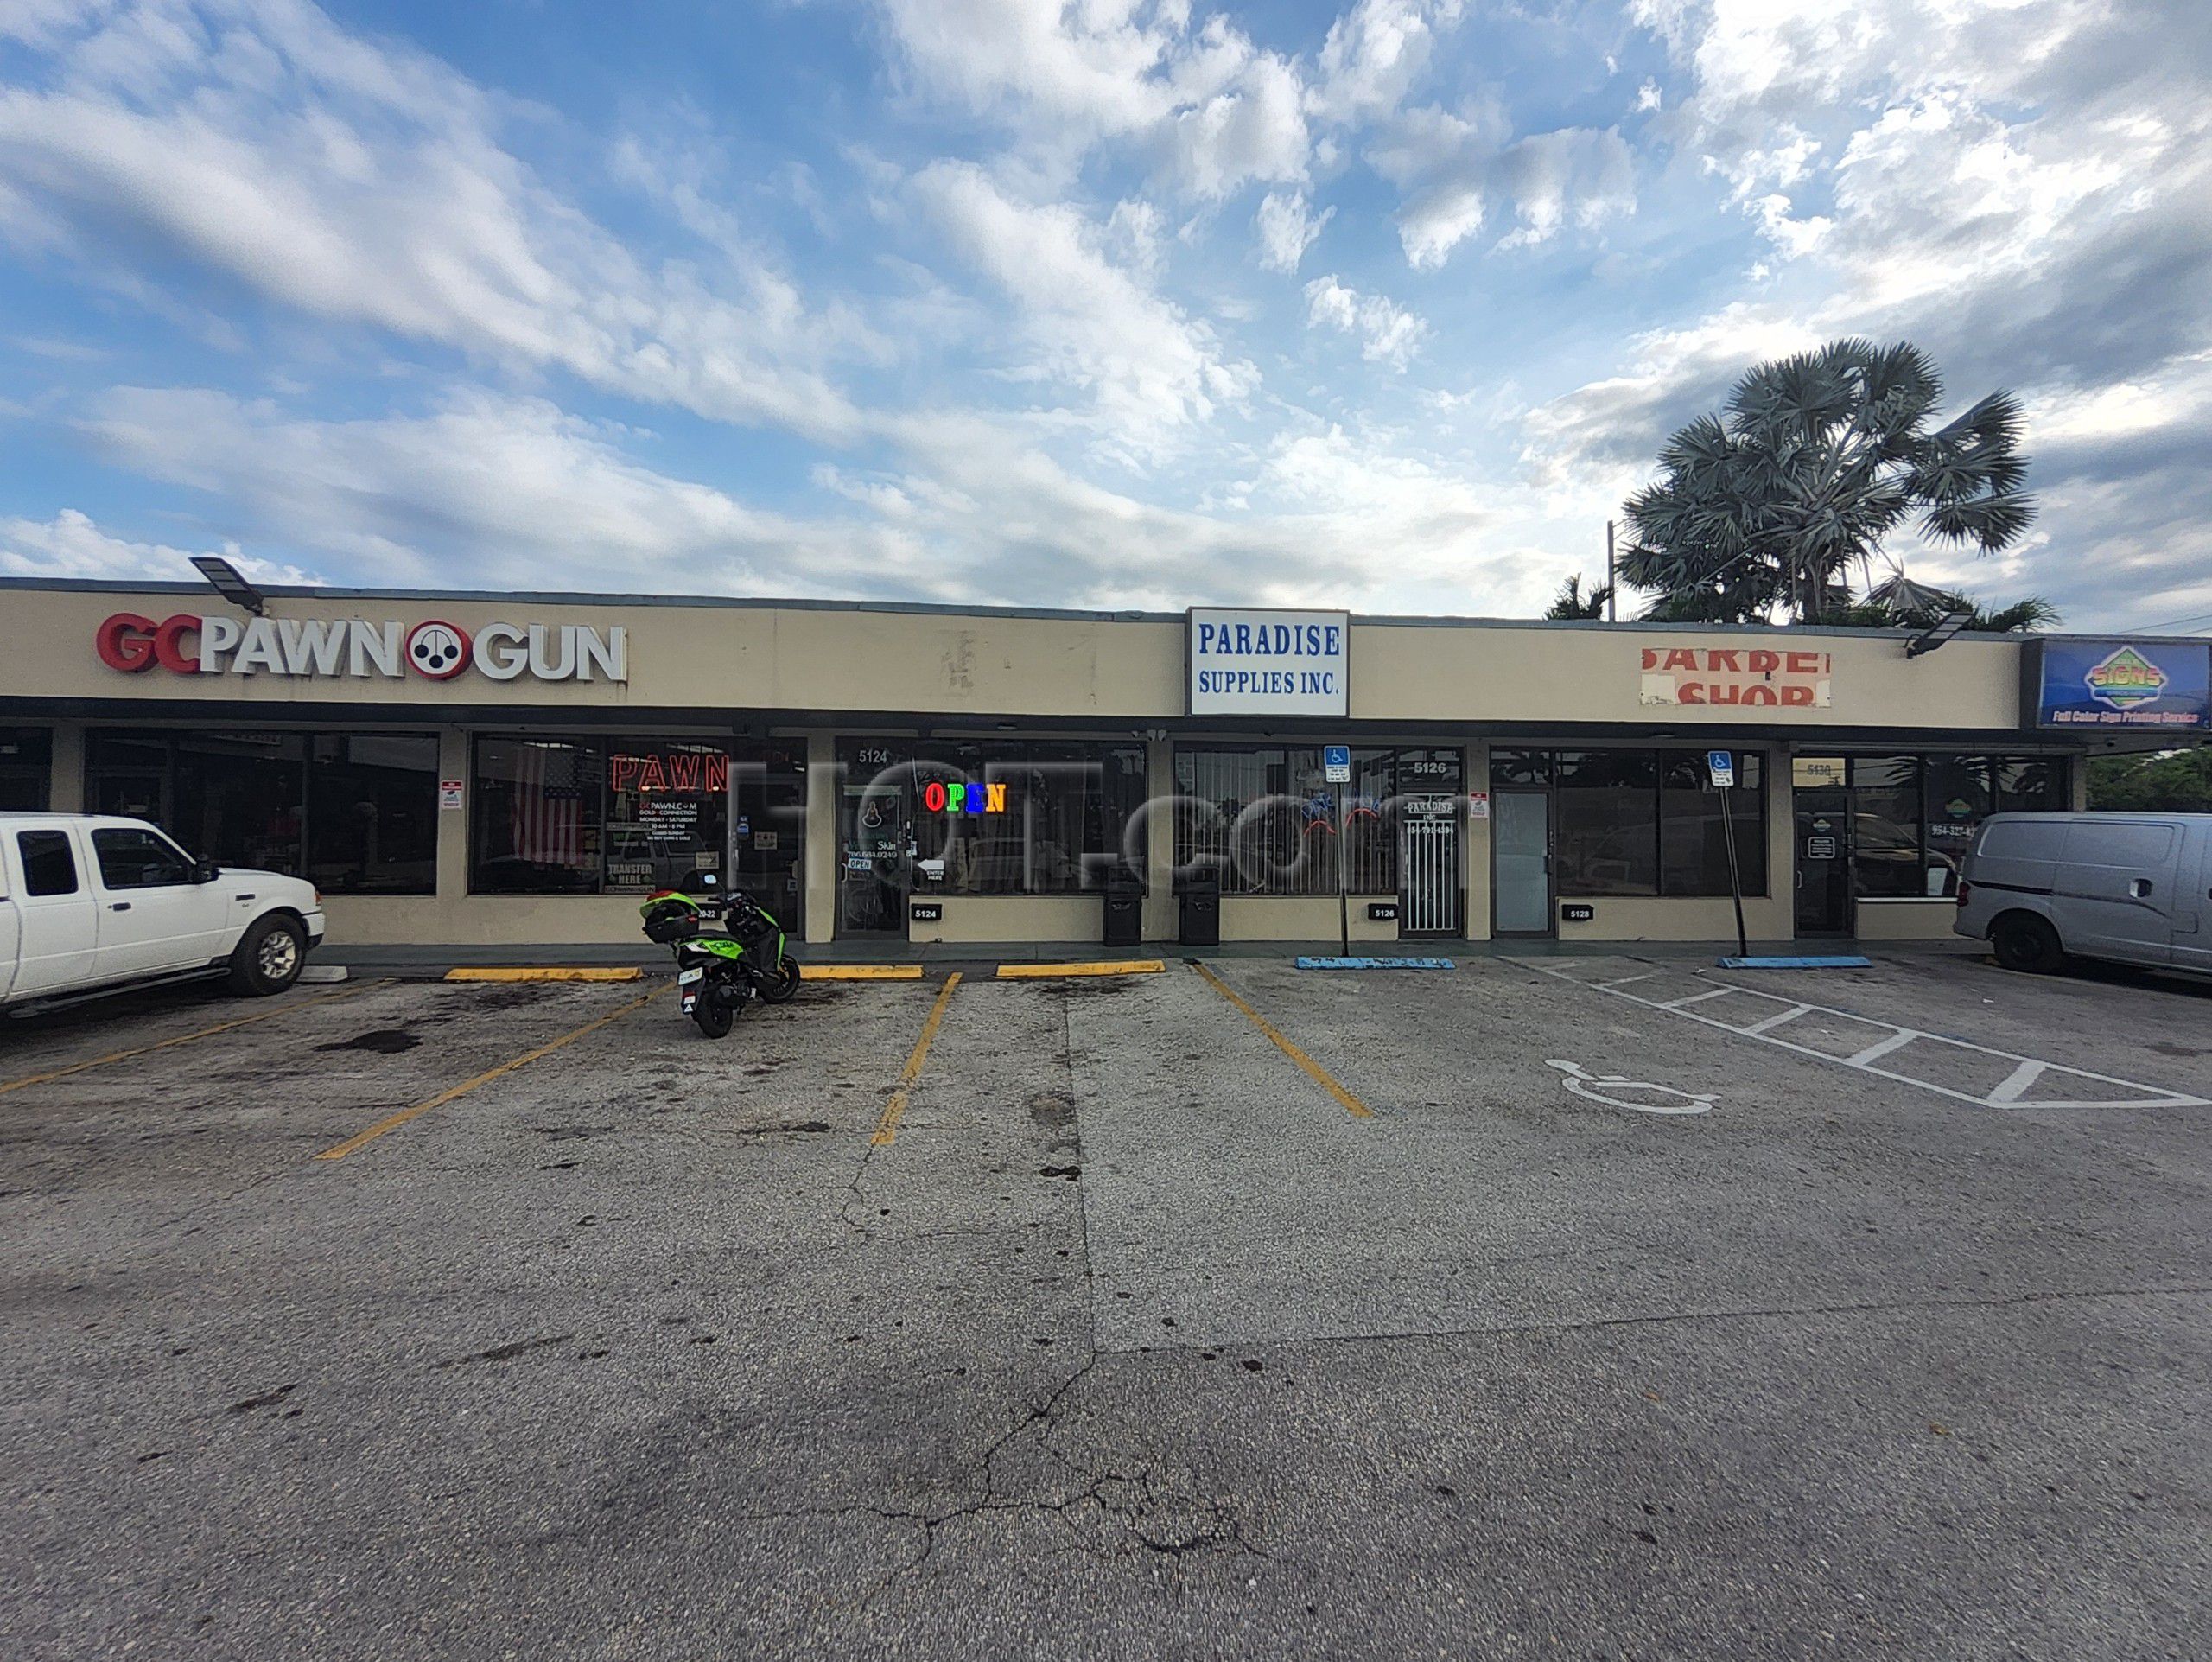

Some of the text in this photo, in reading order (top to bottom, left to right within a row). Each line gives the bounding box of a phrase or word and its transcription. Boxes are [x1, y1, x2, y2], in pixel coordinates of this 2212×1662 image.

[1198, 623, 1339, 656] PARADISE
[472, 621, 627, 681] GUN
[1642, 649, 1830, 673] ARBE
[2092, 665, 2160, 686] SIGNS
[1199, 671, 1339, 694] SUPPLIES INC.
[2053, 711, 2199, 724] Full Color Sign Printing Service
[859, 750, 887, 763] 5124
[612, 754, 730, 793] PAWN
[1414, 762, 1447, 774] 5126
[925, 782, 1007, 812] OPEN
[877, 841, 896, 850] Skin
[607, 864, 652, 875] TRANSFER
[850, 860, 870, 869] OPEN
[618, 875, 641, 884] HERE
[1375, 909, 1395, 918] 5126
